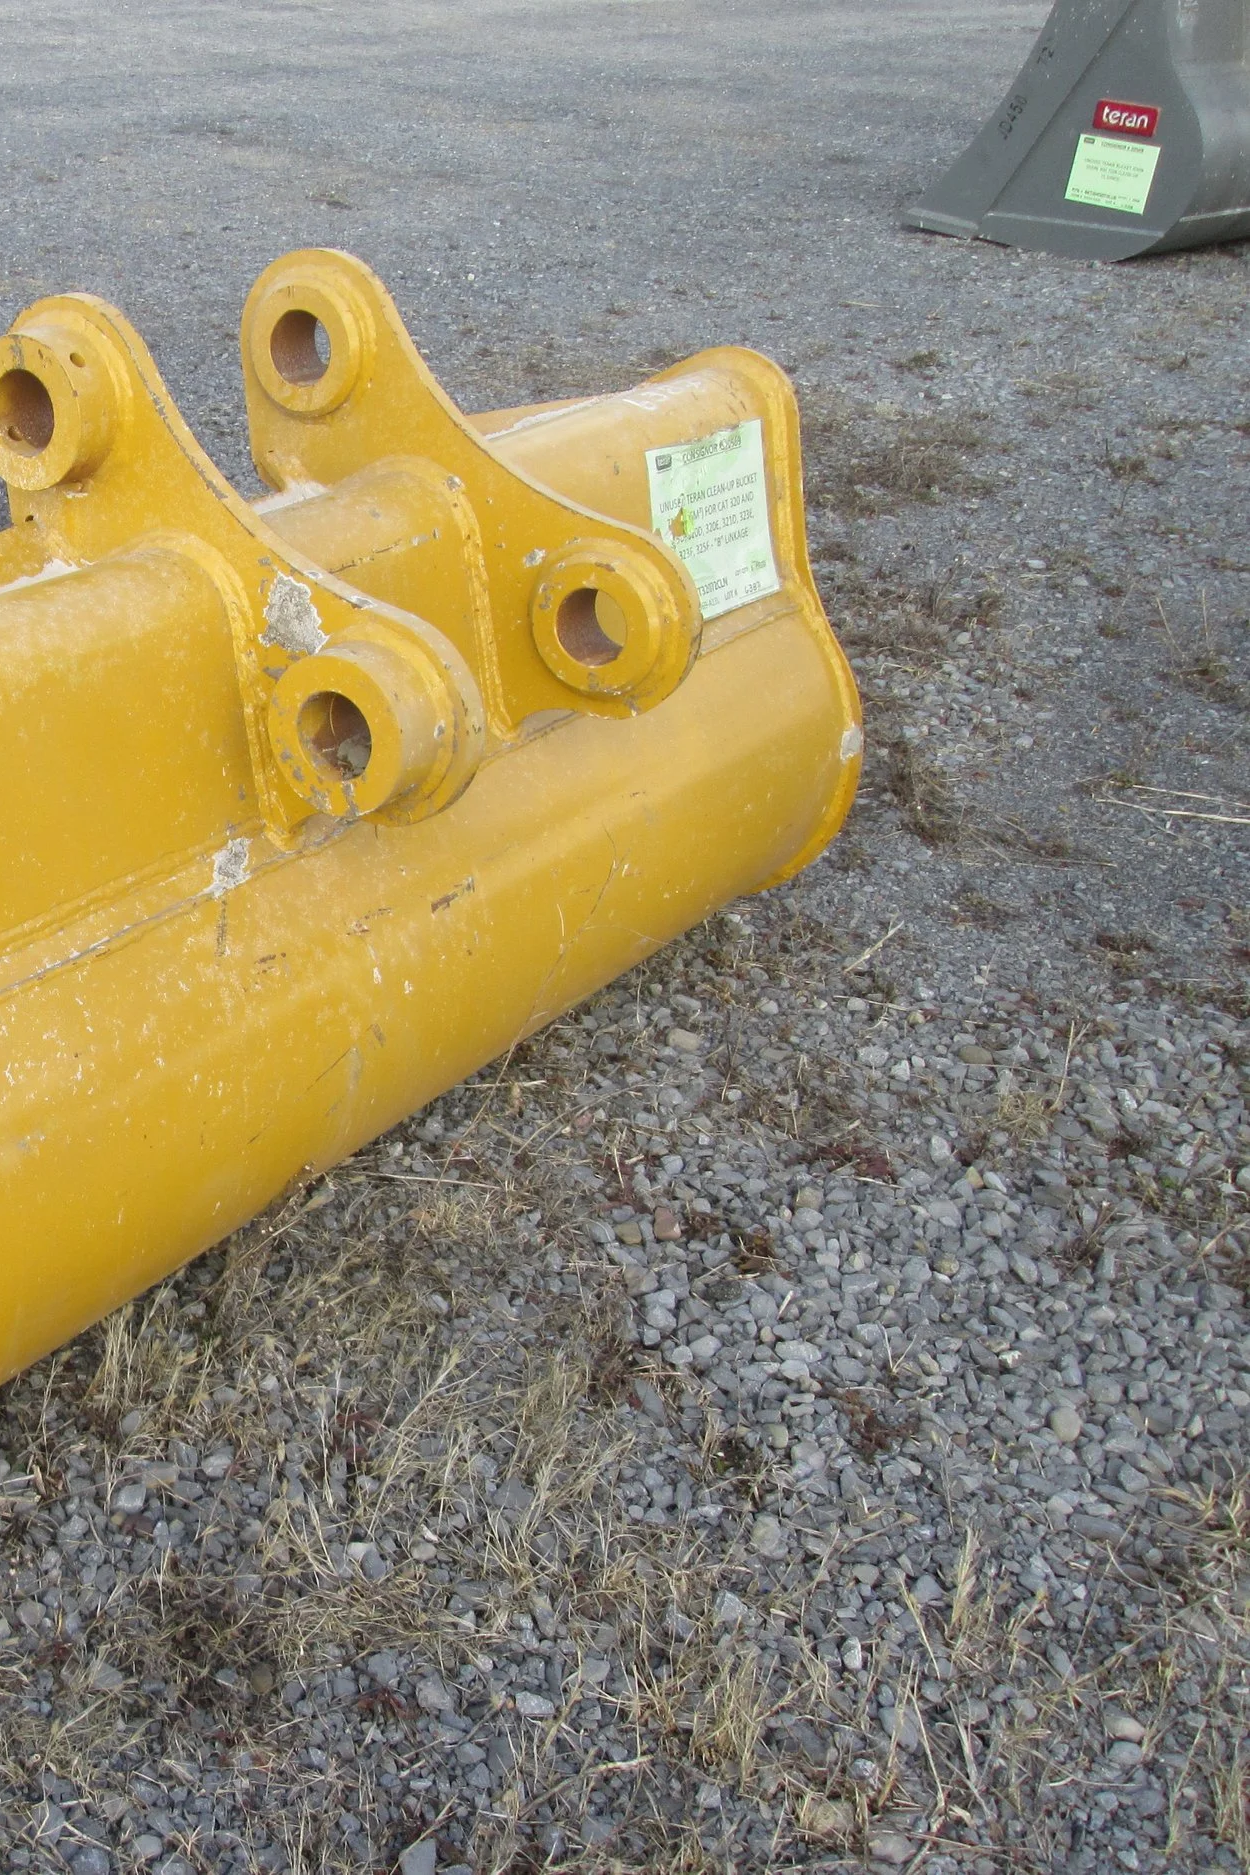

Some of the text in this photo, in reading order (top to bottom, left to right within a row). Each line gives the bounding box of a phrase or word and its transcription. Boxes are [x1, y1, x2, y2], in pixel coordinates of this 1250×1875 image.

[1102, 105, 1149, 128] teran
[682, 444, 718, 465] CONSIGNOR
[687, 490, 705, 504] TERAN
[706, 479, 734, 498] CLEAN-UP
[735, 472, 757, 487] BUCKET
[705, 491, 754, 516] FOR CAT 320 AND
[725, 527, 749, 544] LINKAGE
